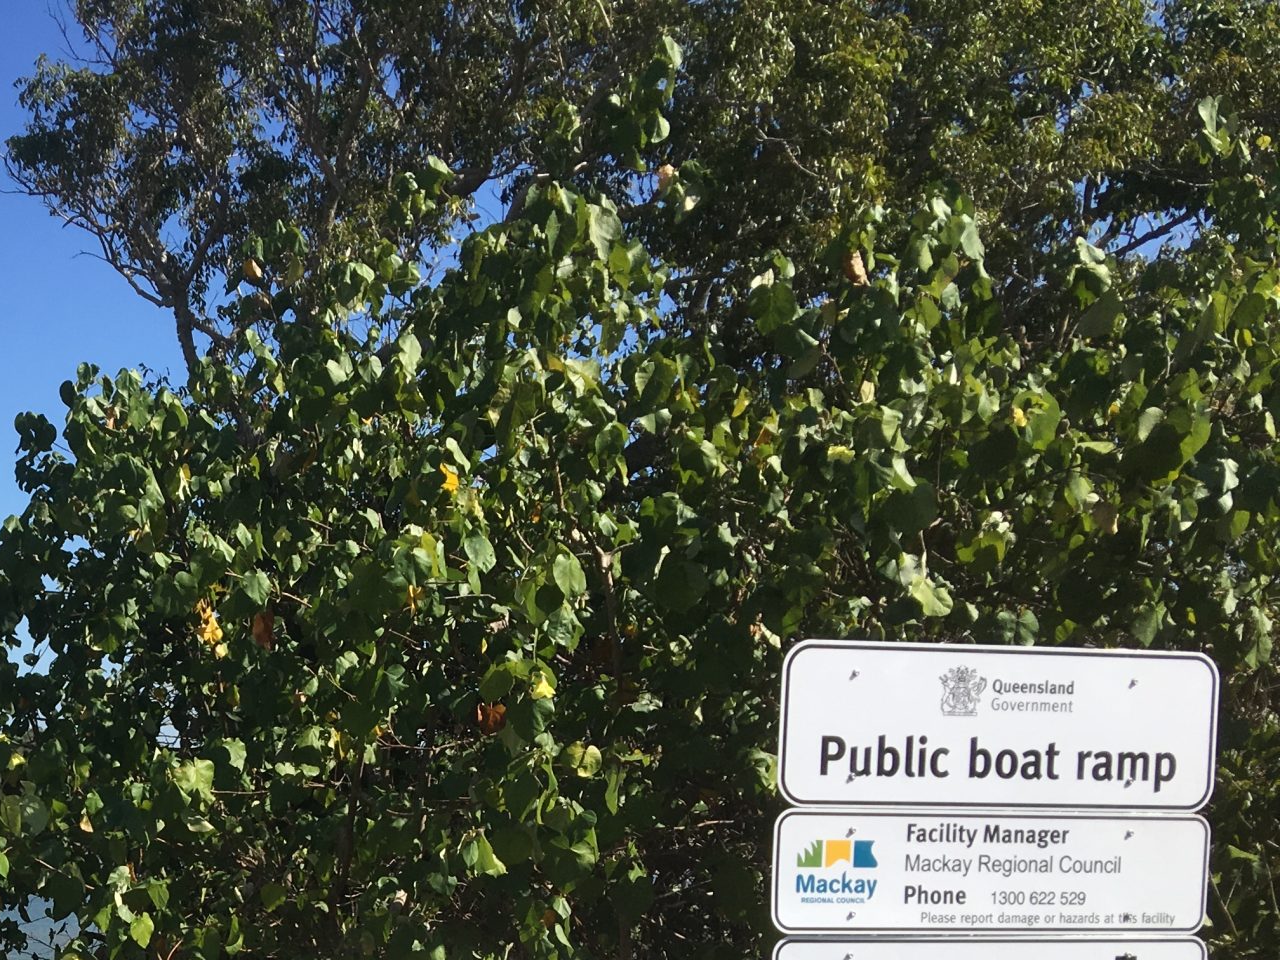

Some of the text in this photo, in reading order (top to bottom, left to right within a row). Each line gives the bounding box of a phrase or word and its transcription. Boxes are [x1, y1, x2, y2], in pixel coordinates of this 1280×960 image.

[992, 678, 1074, 697] Queensland
[991, 698, 1074, 713] Government
[820, 735, 1176, 792] Public boat ramp
[907, 824, 1069, 849] Facility Manager
[905, 855, 1121, 877] Mackay Regional Council
[796, 871, 877, 900] Mackay
[904, 886, 1086, 906] Phone 1300 622 529
[921, 912, 956, 923] Please
[961, 914, 993, 926] report
[998, 912, 1039, 926] damage
[1044, 915, 1056, 923] or
[1060, 913, 1100, 923] hazards
[1104, 914, 1114, 923] at
[1142, 912, 1175, 926] facility
